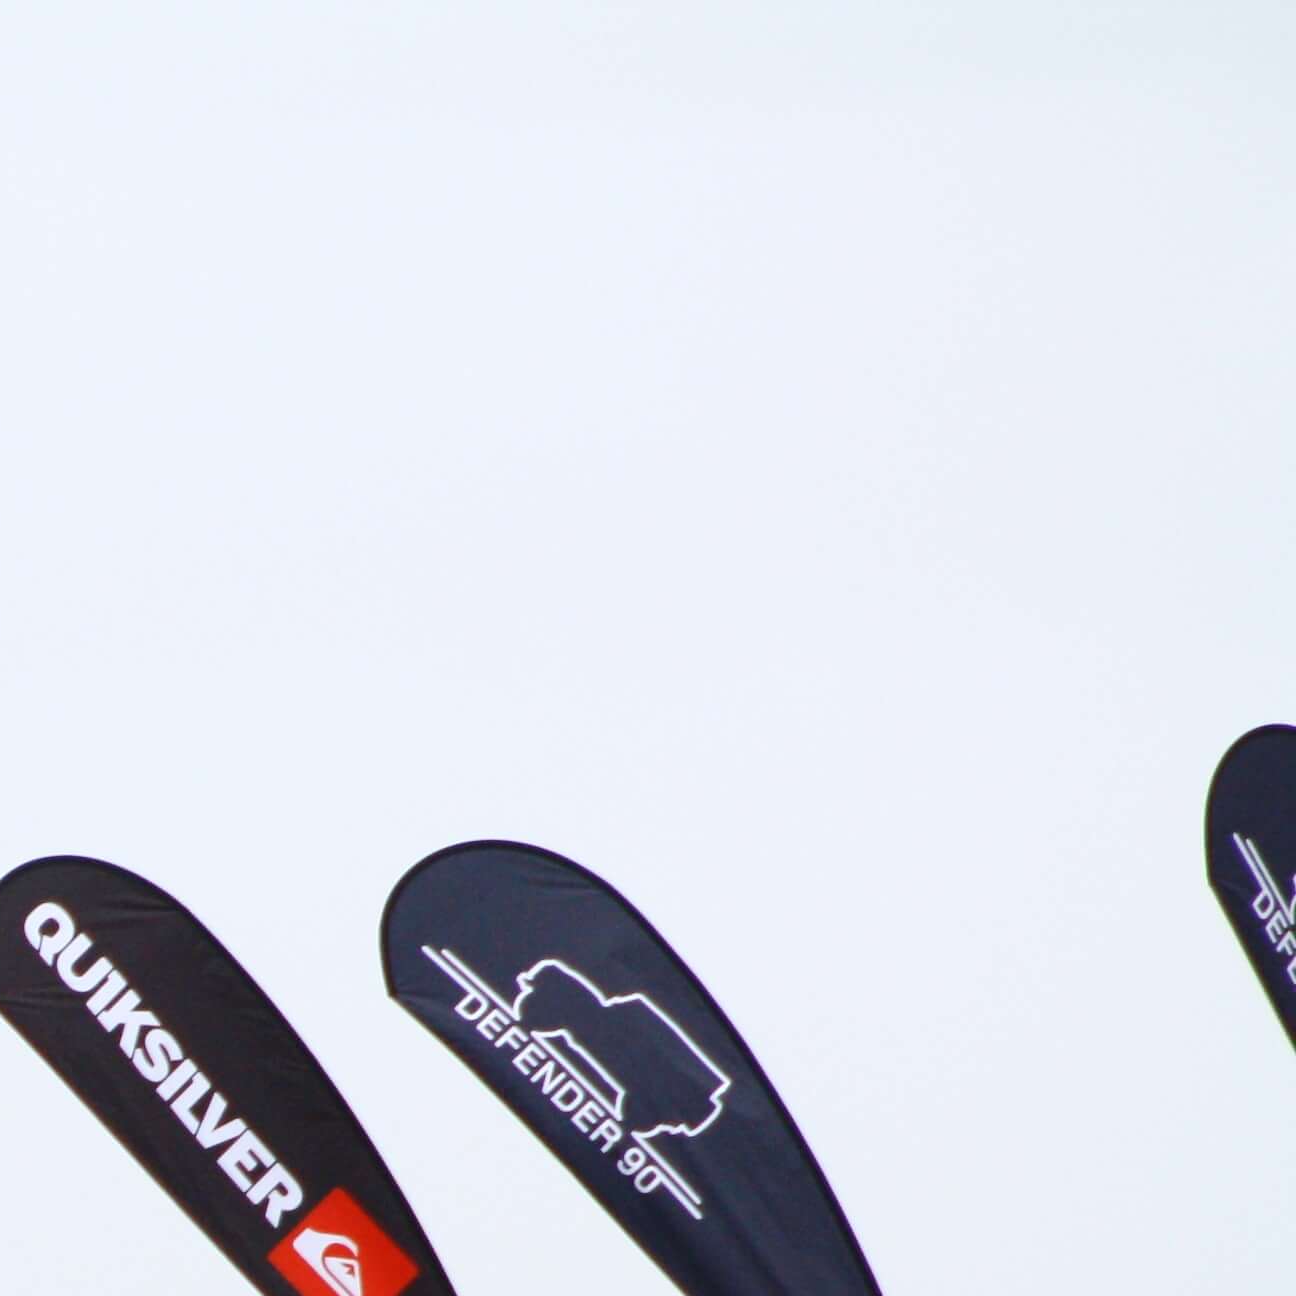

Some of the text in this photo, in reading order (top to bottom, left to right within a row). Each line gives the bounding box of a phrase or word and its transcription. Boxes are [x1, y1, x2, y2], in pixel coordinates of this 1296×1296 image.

[23, 901, 304, 1229] QUIKSILVER
[454, 992, 660, 1193] DEFENDER 90
